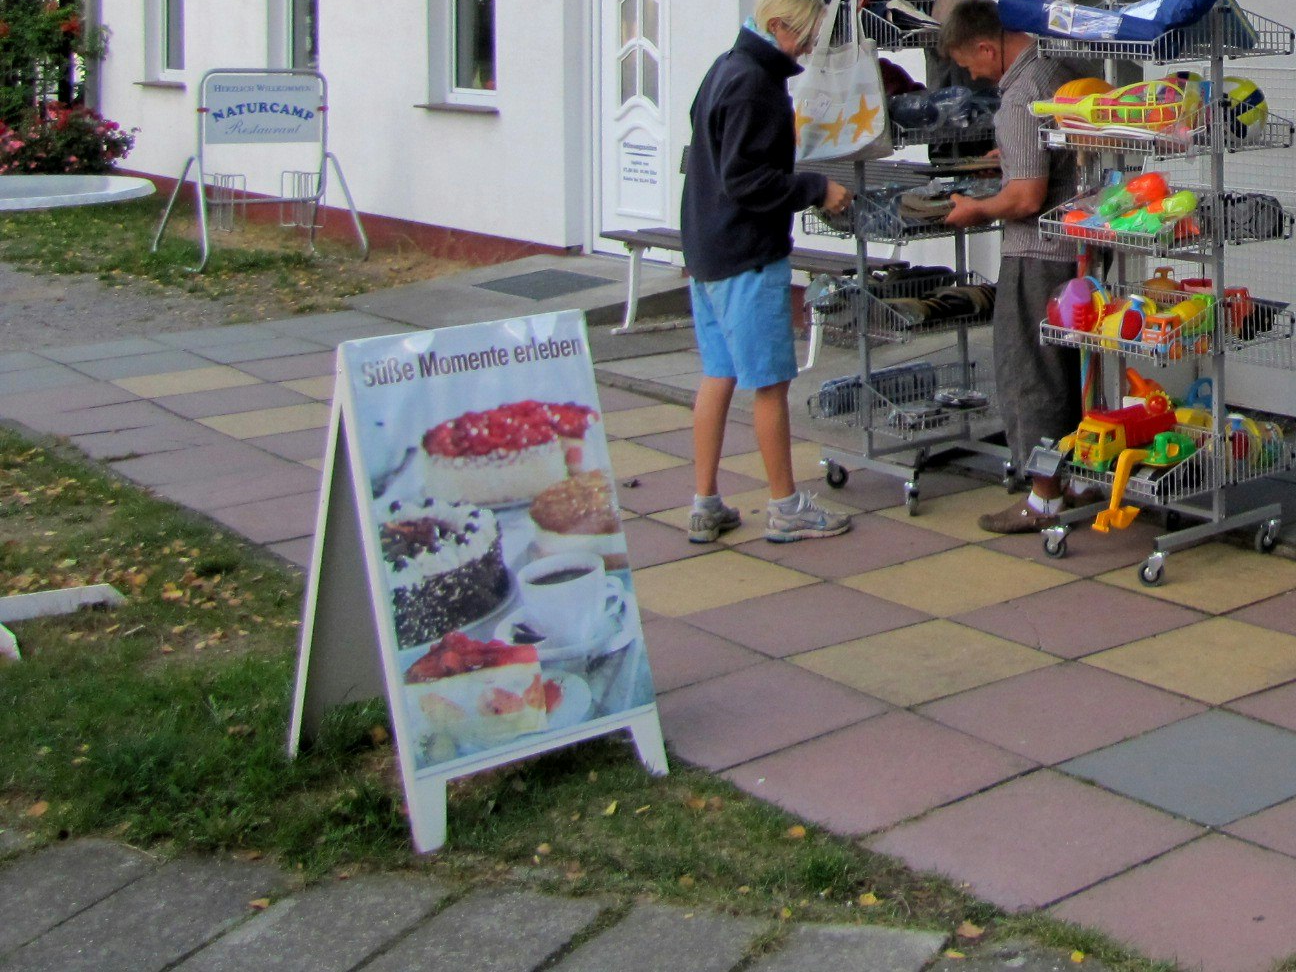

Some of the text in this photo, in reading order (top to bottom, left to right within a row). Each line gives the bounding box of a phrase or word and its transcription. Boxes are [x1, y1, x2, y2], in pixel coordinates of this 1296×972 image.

[212, 102, 314, 122] NATURCAMP
[225, 120, 301, 135] Restaurant
[361, 336, 582, 388] Süße Momente erleben
